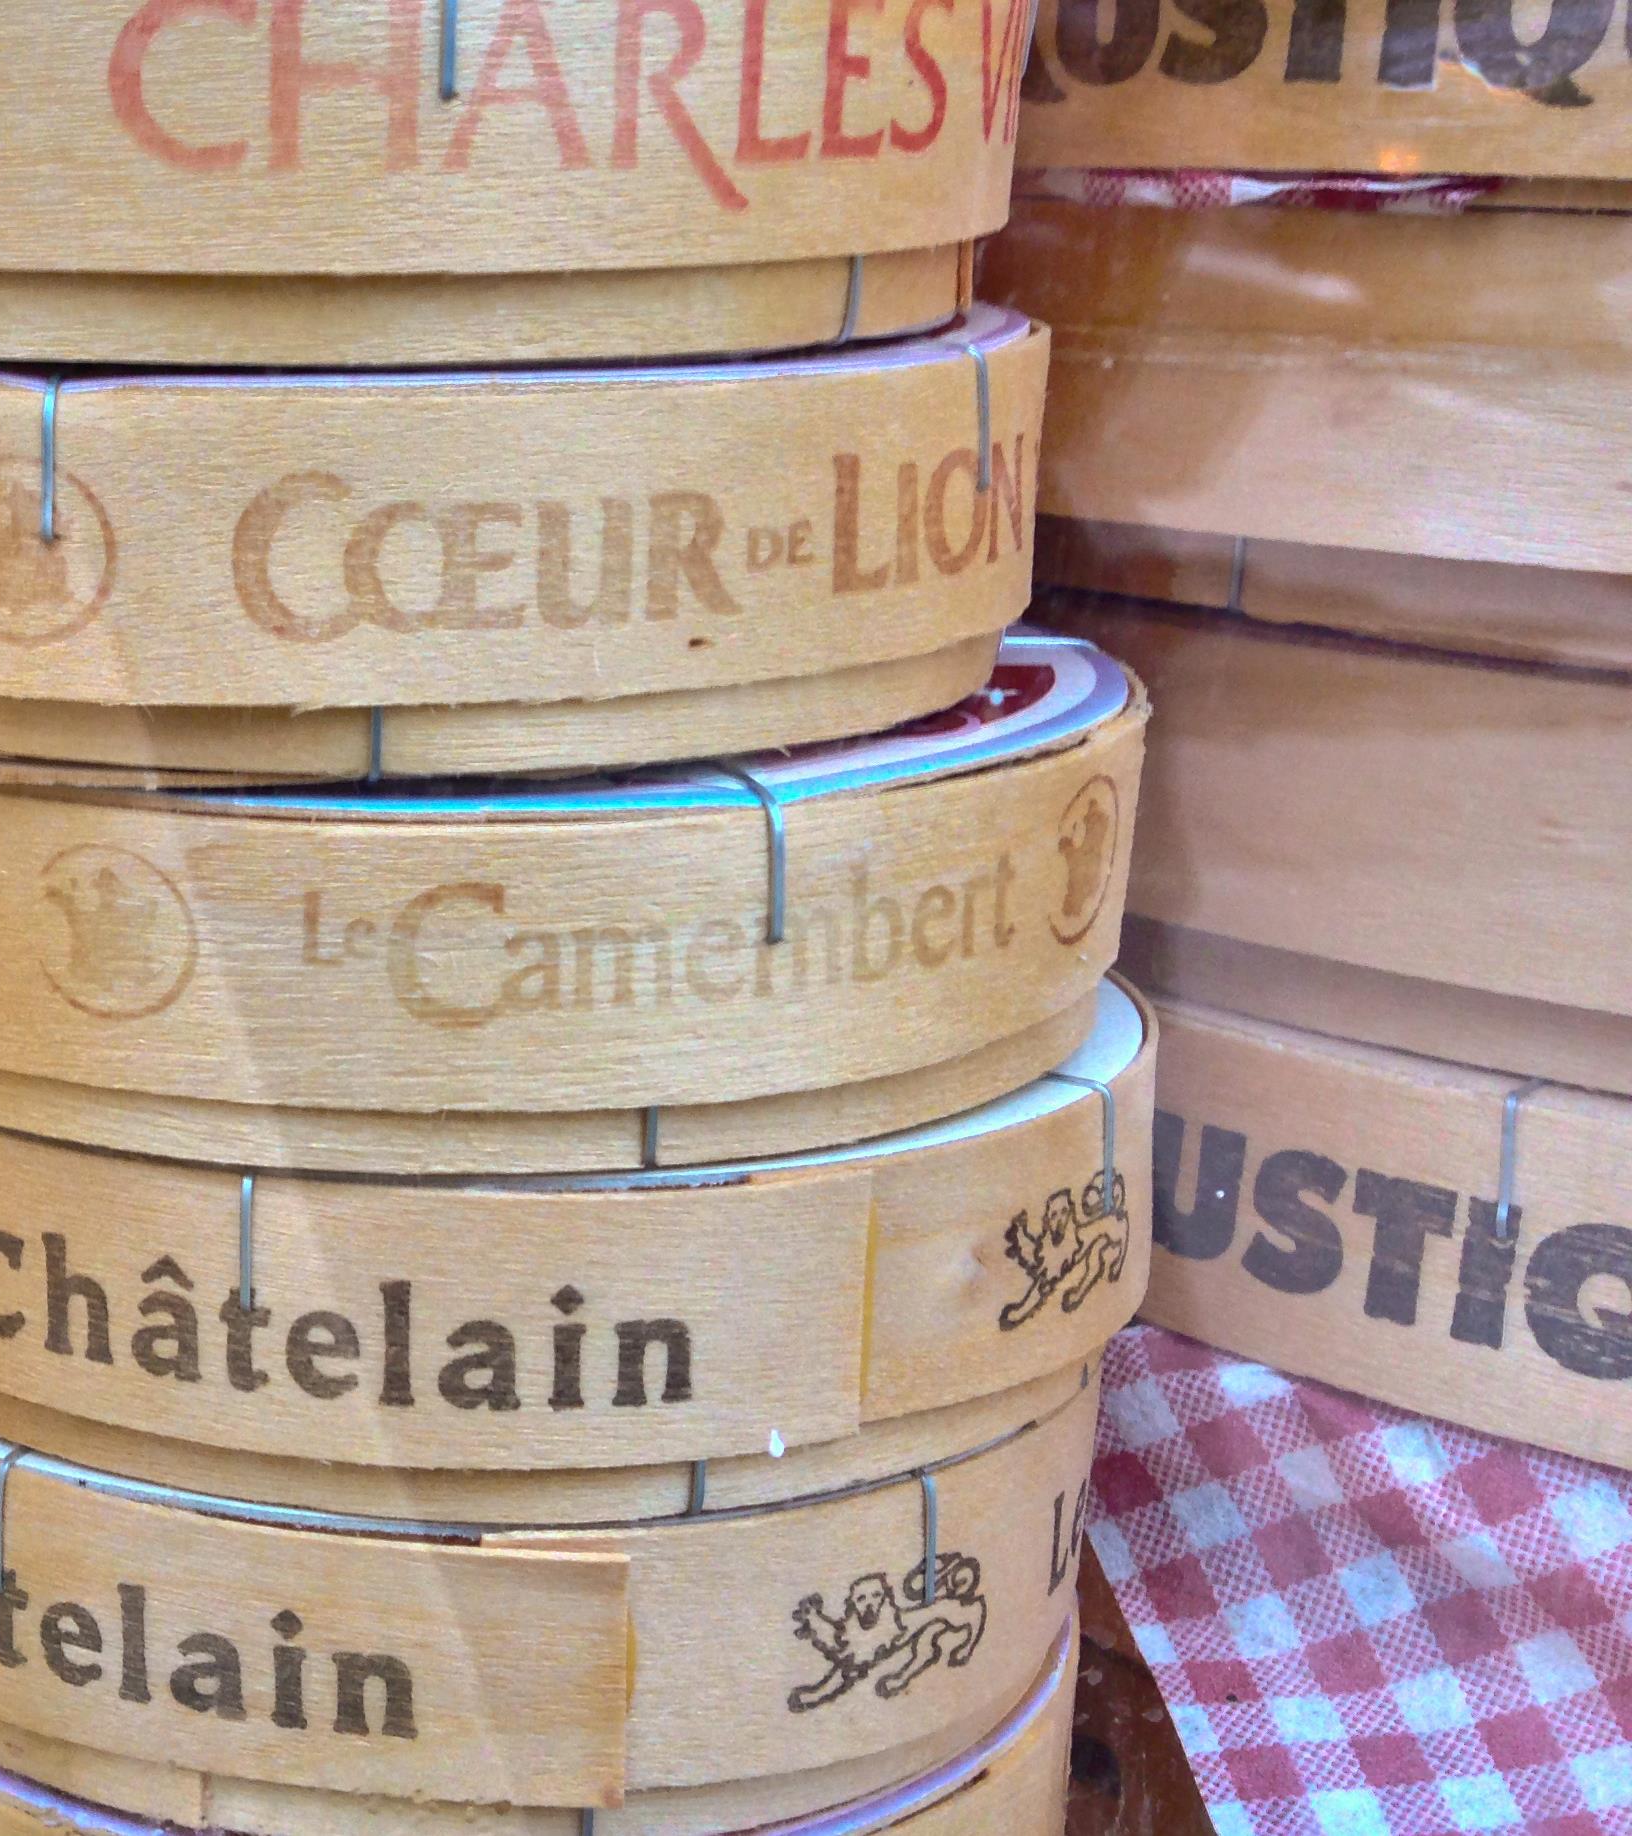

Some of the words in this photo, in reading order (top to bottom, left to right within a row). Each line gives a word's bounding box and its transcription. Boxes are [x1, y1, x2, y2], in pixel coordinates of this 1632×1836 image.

[106, 0, 948, 212] CHARLES
[746, 520, 816, 574] DE
[831, 433, 1024, 594] LION
[301, 890, 371, 967] Le
[386, 853, 1016, 1028] Camembert
